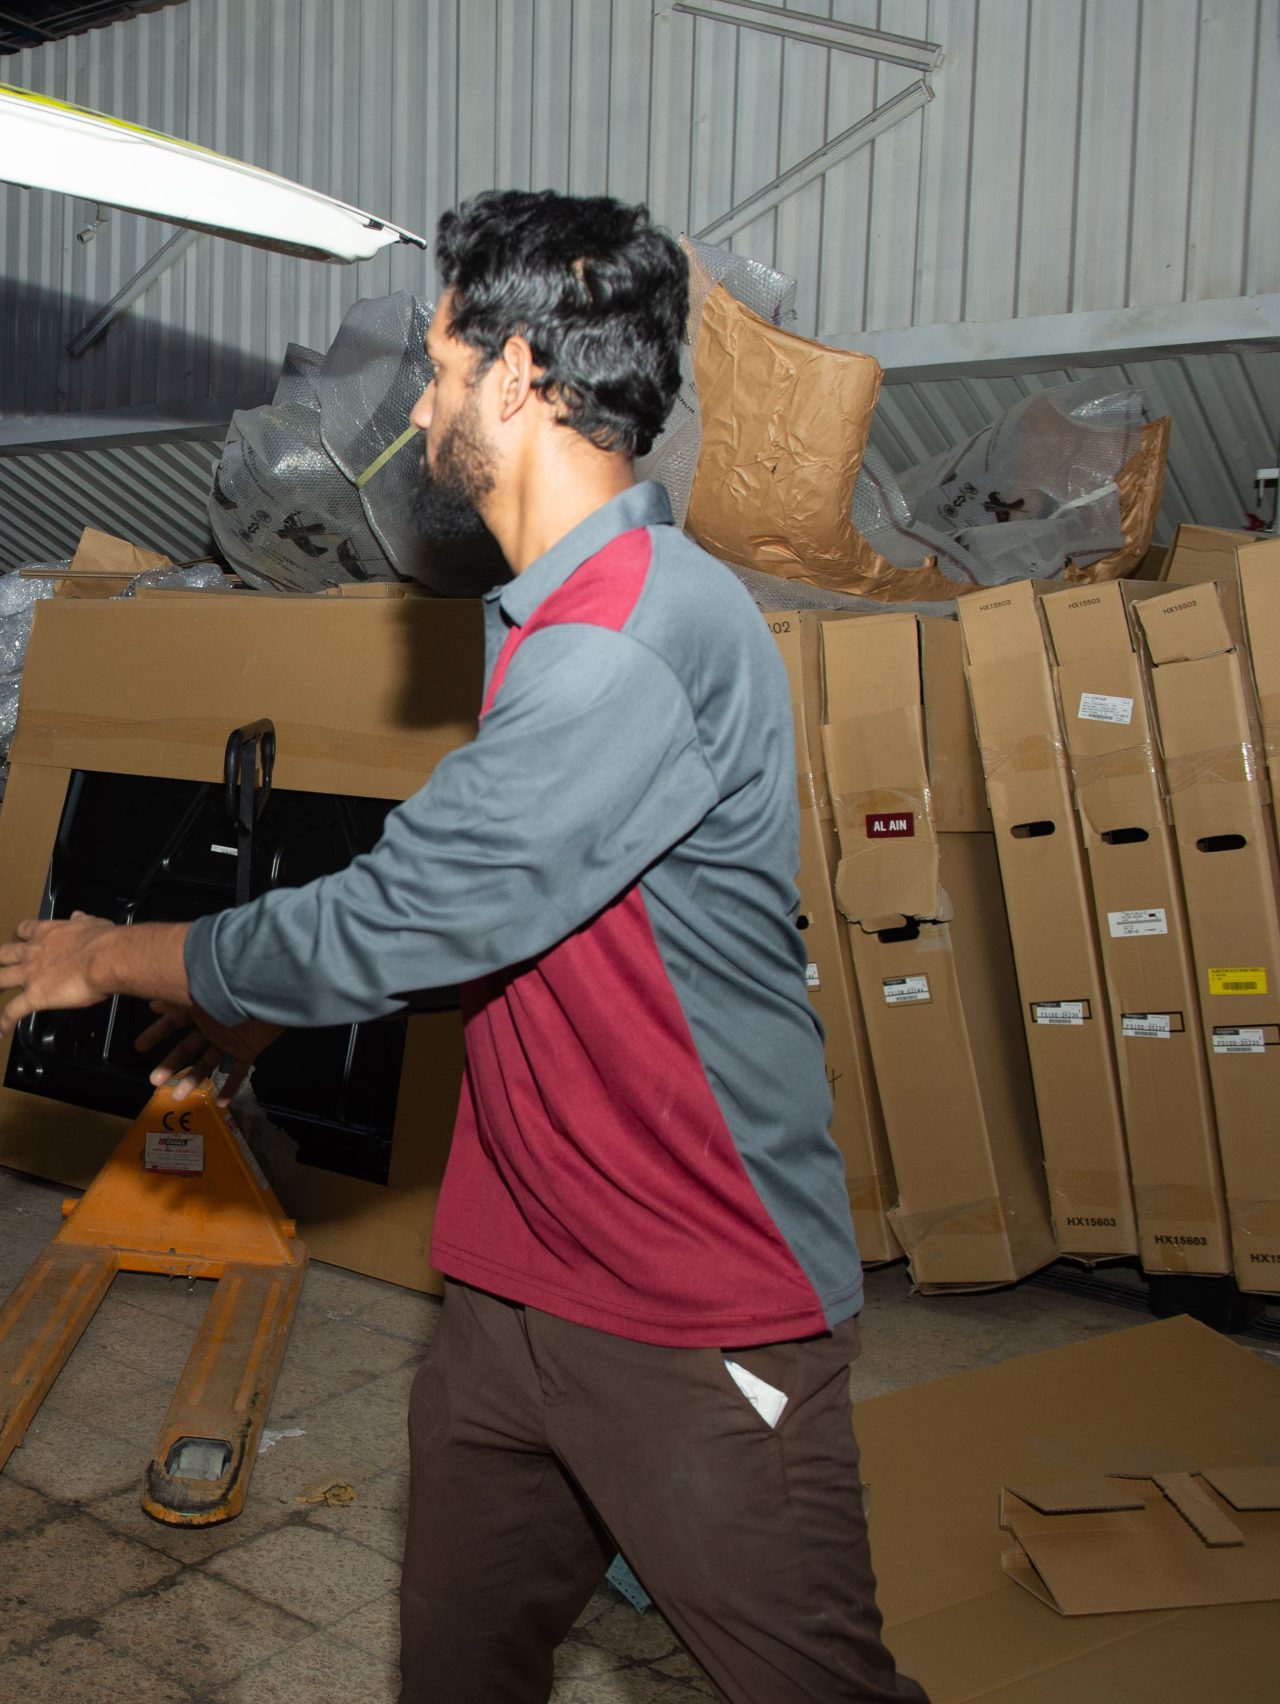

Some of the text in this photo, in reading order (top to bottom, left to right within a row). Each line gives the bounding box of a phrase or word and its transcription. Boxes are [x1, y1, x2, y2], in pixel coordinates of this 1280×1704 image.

[873, 819, 907, 832] AL AIN
[1066, 1217, 1117, 1227] HX15603
[1154, 1234, 1207, 1246] HX15603
